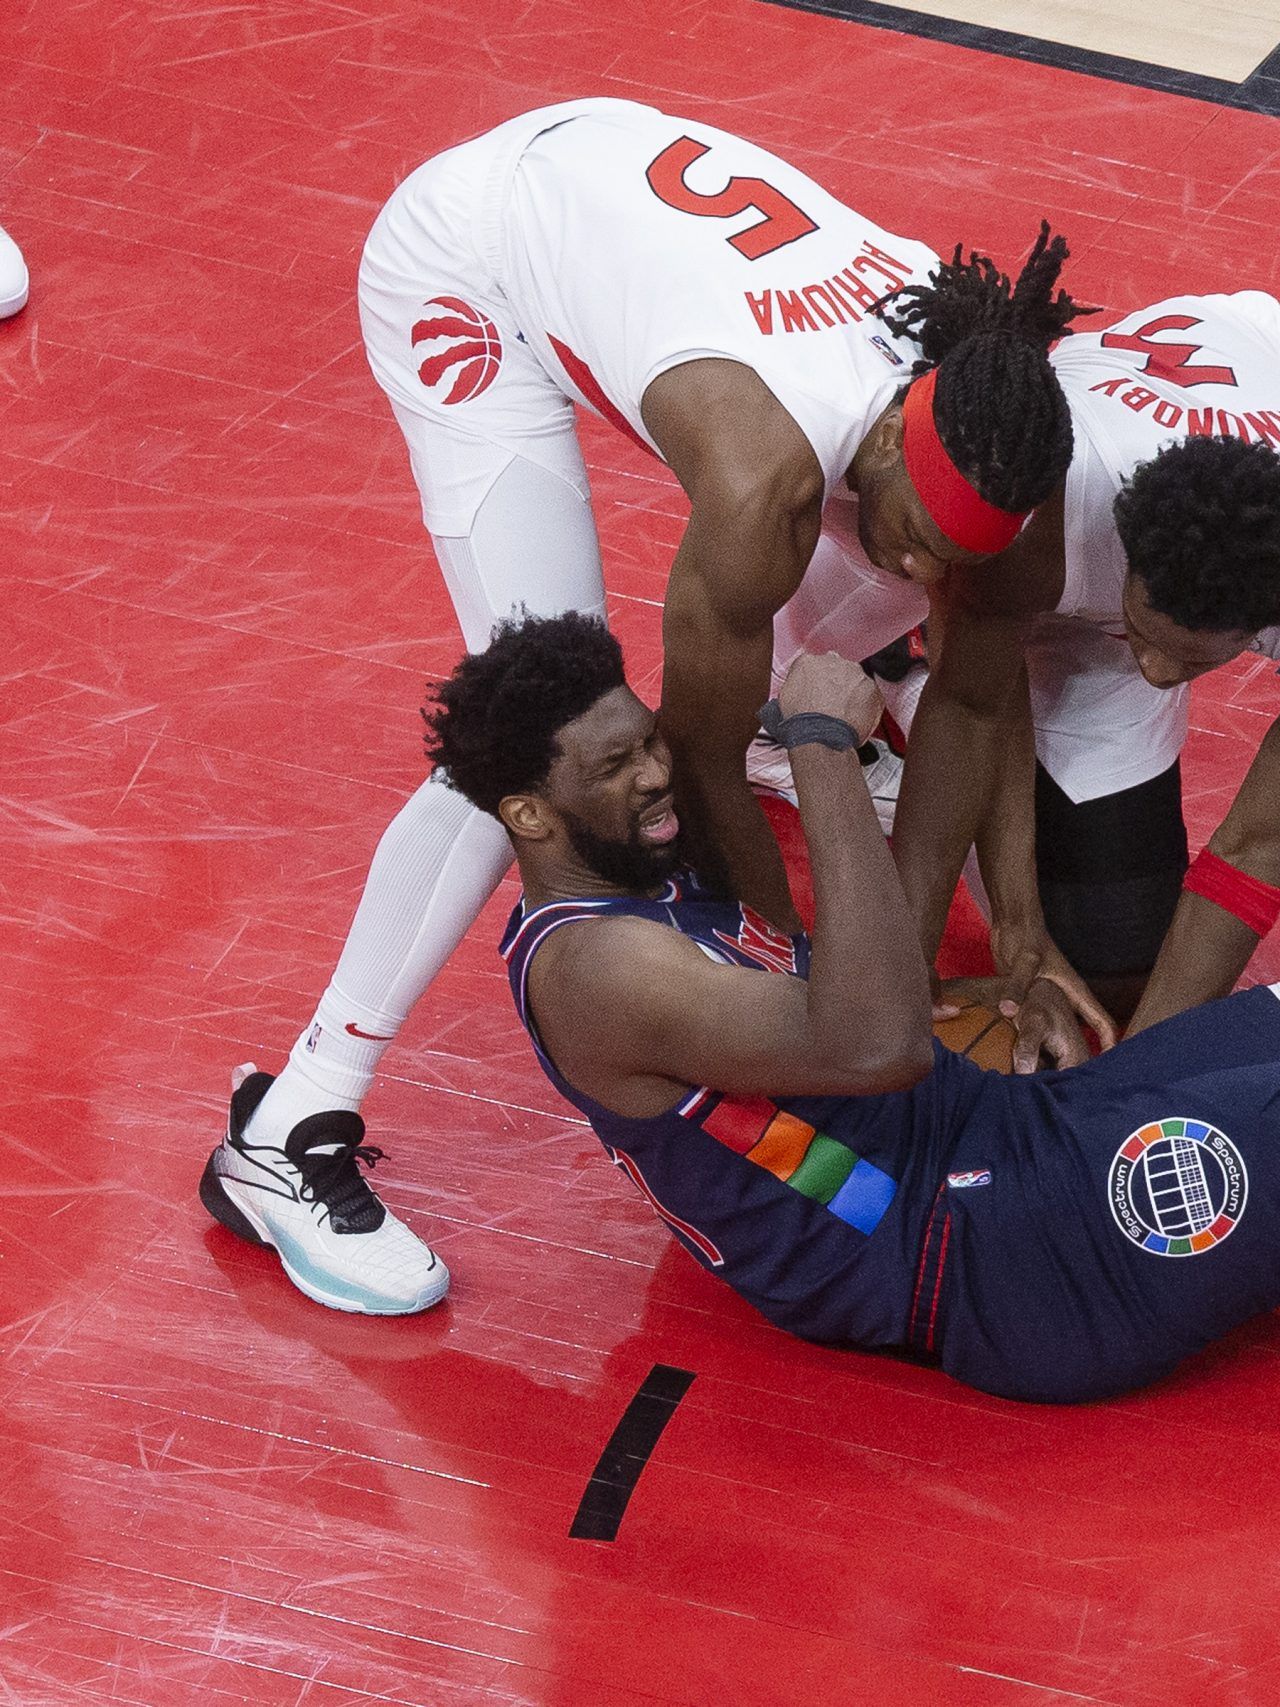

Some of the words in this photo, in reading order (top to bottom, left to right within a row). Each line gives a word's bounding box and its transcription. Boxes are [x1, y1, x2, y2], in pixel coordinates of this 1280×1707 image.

[645, 134, 820, 261] 5
[744, 240, 913, 335] ACHIUWA
[1114, 1163, 1143, 1239] Spectrum
[1211, 1136, 1241, 1213] Spectrum
